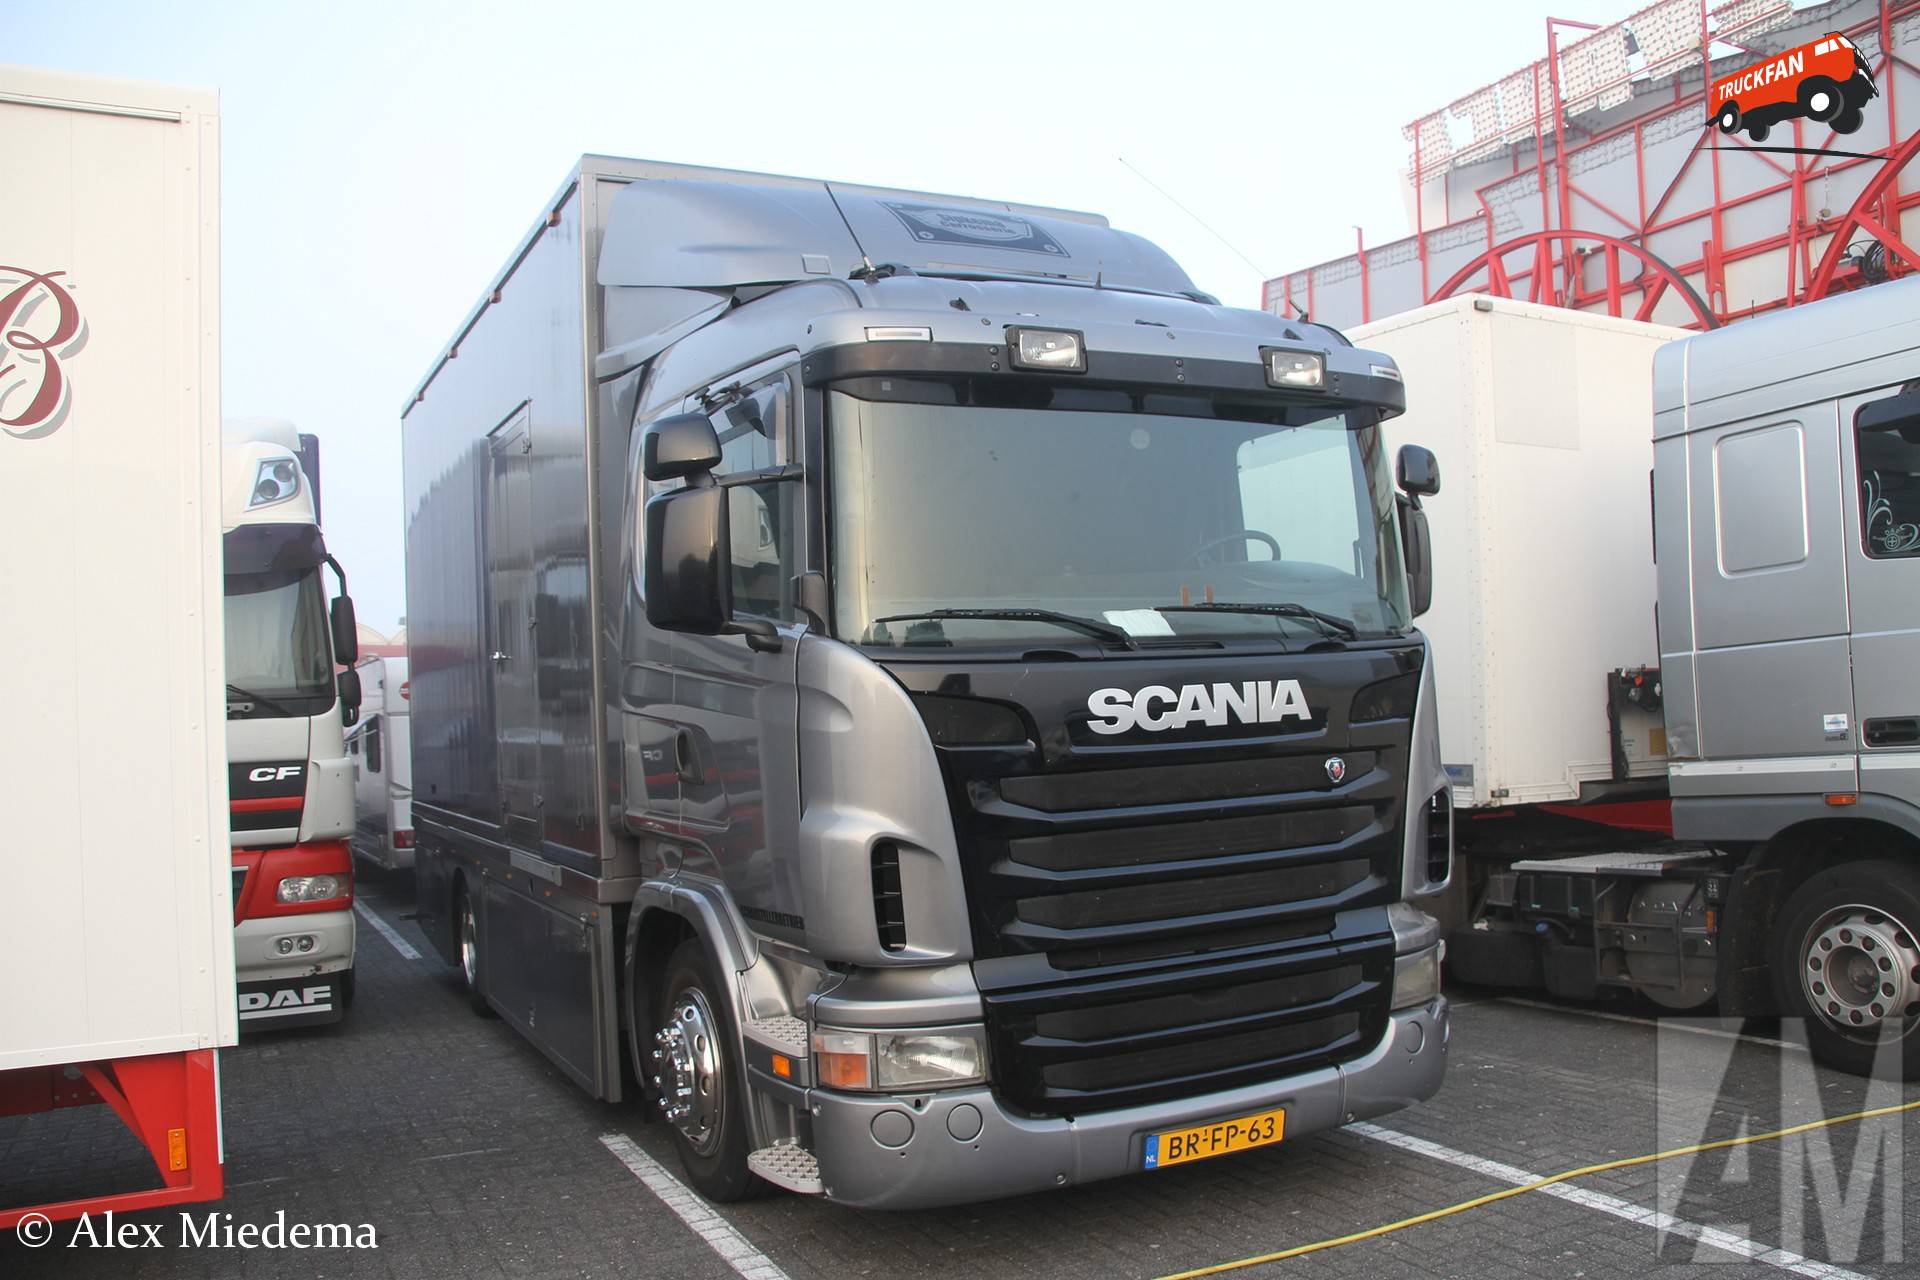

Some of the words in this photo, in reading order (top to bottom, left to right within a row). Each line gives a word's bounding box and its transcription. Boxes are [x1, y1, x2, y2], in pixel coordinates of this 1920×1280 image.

[1087, 679, 1312, 735] SCANIA
[249, 766, 302, 782] CF
[239, 985, 332, 1010] DAF
[1145, 1154, 1157, 1164] NL
[1168, 1117, 1275, 1160] BR-FP-63
